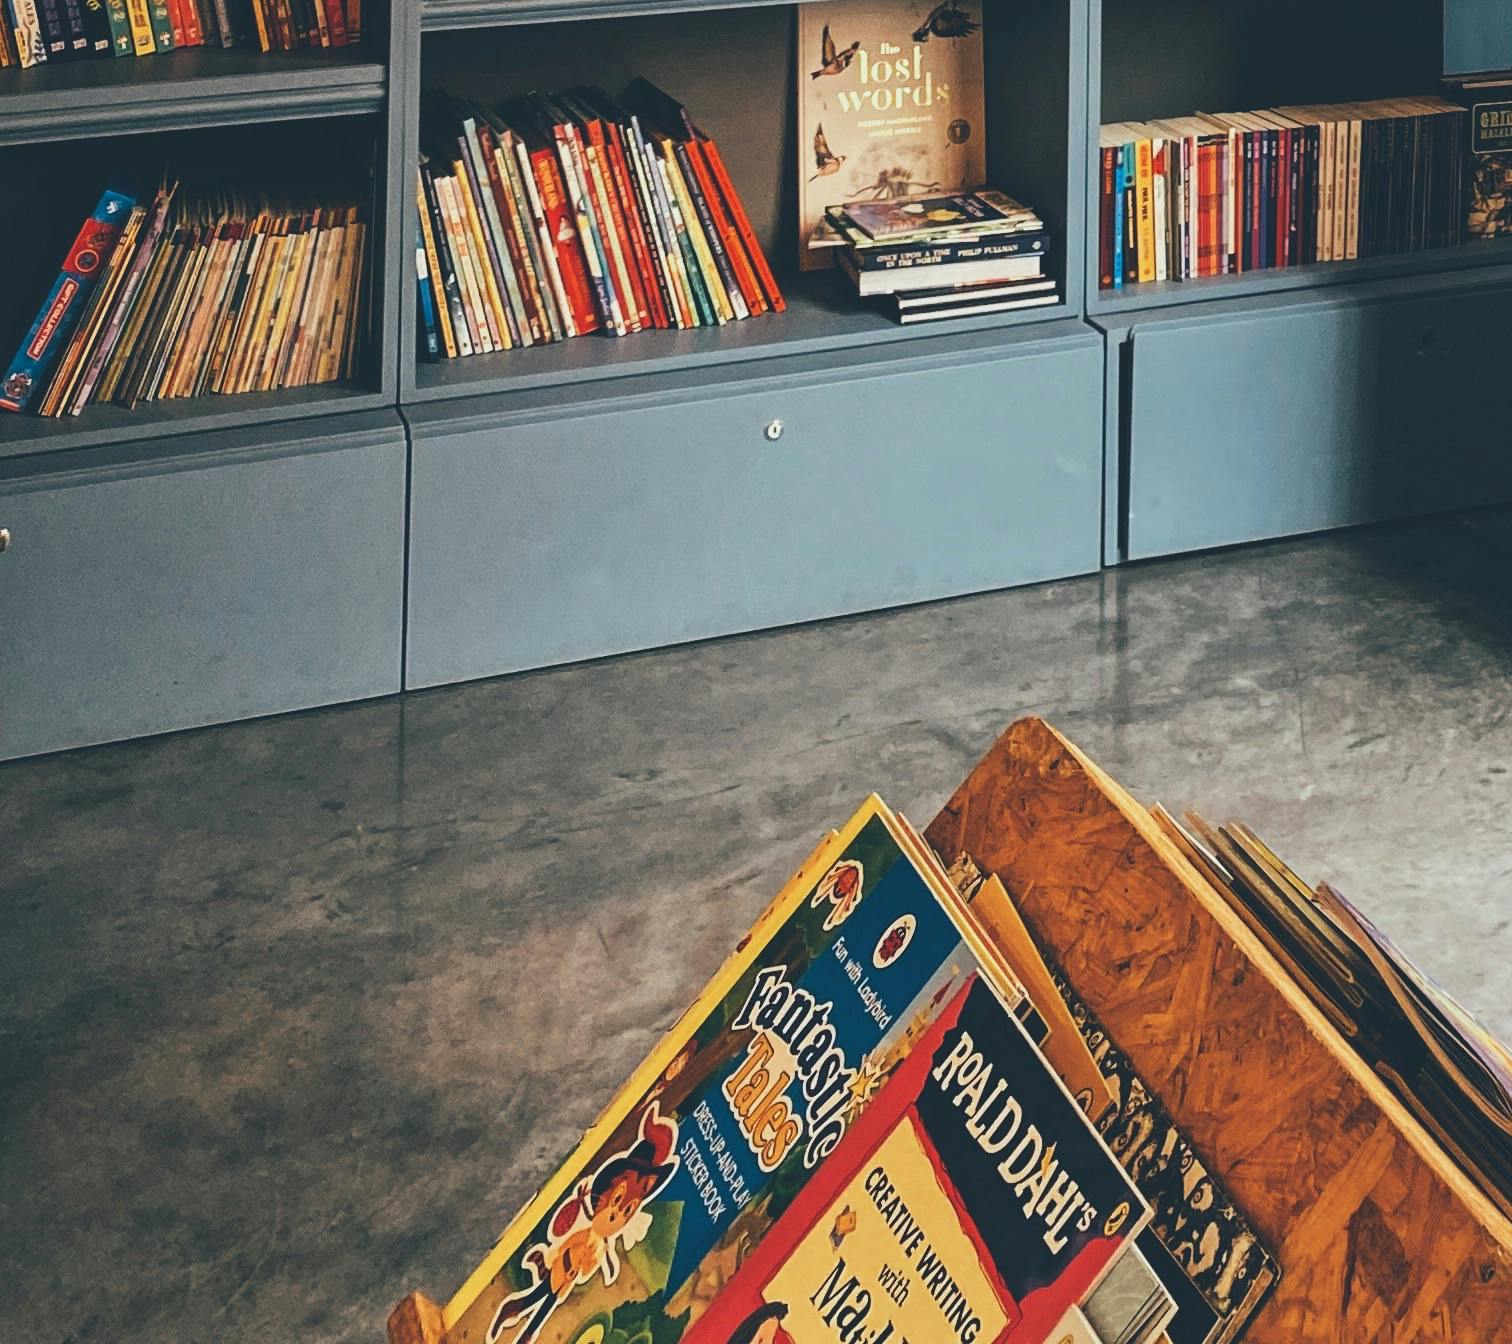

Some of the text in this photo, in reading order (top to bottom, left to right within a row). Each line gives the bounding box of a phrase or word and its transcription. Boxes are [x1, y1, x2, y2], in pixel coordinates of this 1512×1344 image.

[836, 72, 950, 112] words
[859, 46, 922, 84] lost
[880, 43, 900, 54] the
[900, 252, 922, 260] UPON
[958, 248, 981, 256] PHILIP
[984, 244, 1018, 254] PULLMAN
[831, 935, 893, 1030] Fun with Ladybird
[724, 1032, 802, 1172] Tales
[733, 966, 851, 1168] Fantastic
[680, 1138, 727, 1224] STICKER BOOK
[693, 1101, 750, 1210] DRESS-UP-AND-PLAY
[932, 1031, 1097, 1255] ROALD DAHL'S
[864, 1166, 981, 1344] CREATIVE WRITING
[877, 1263, 913, 1307] with
